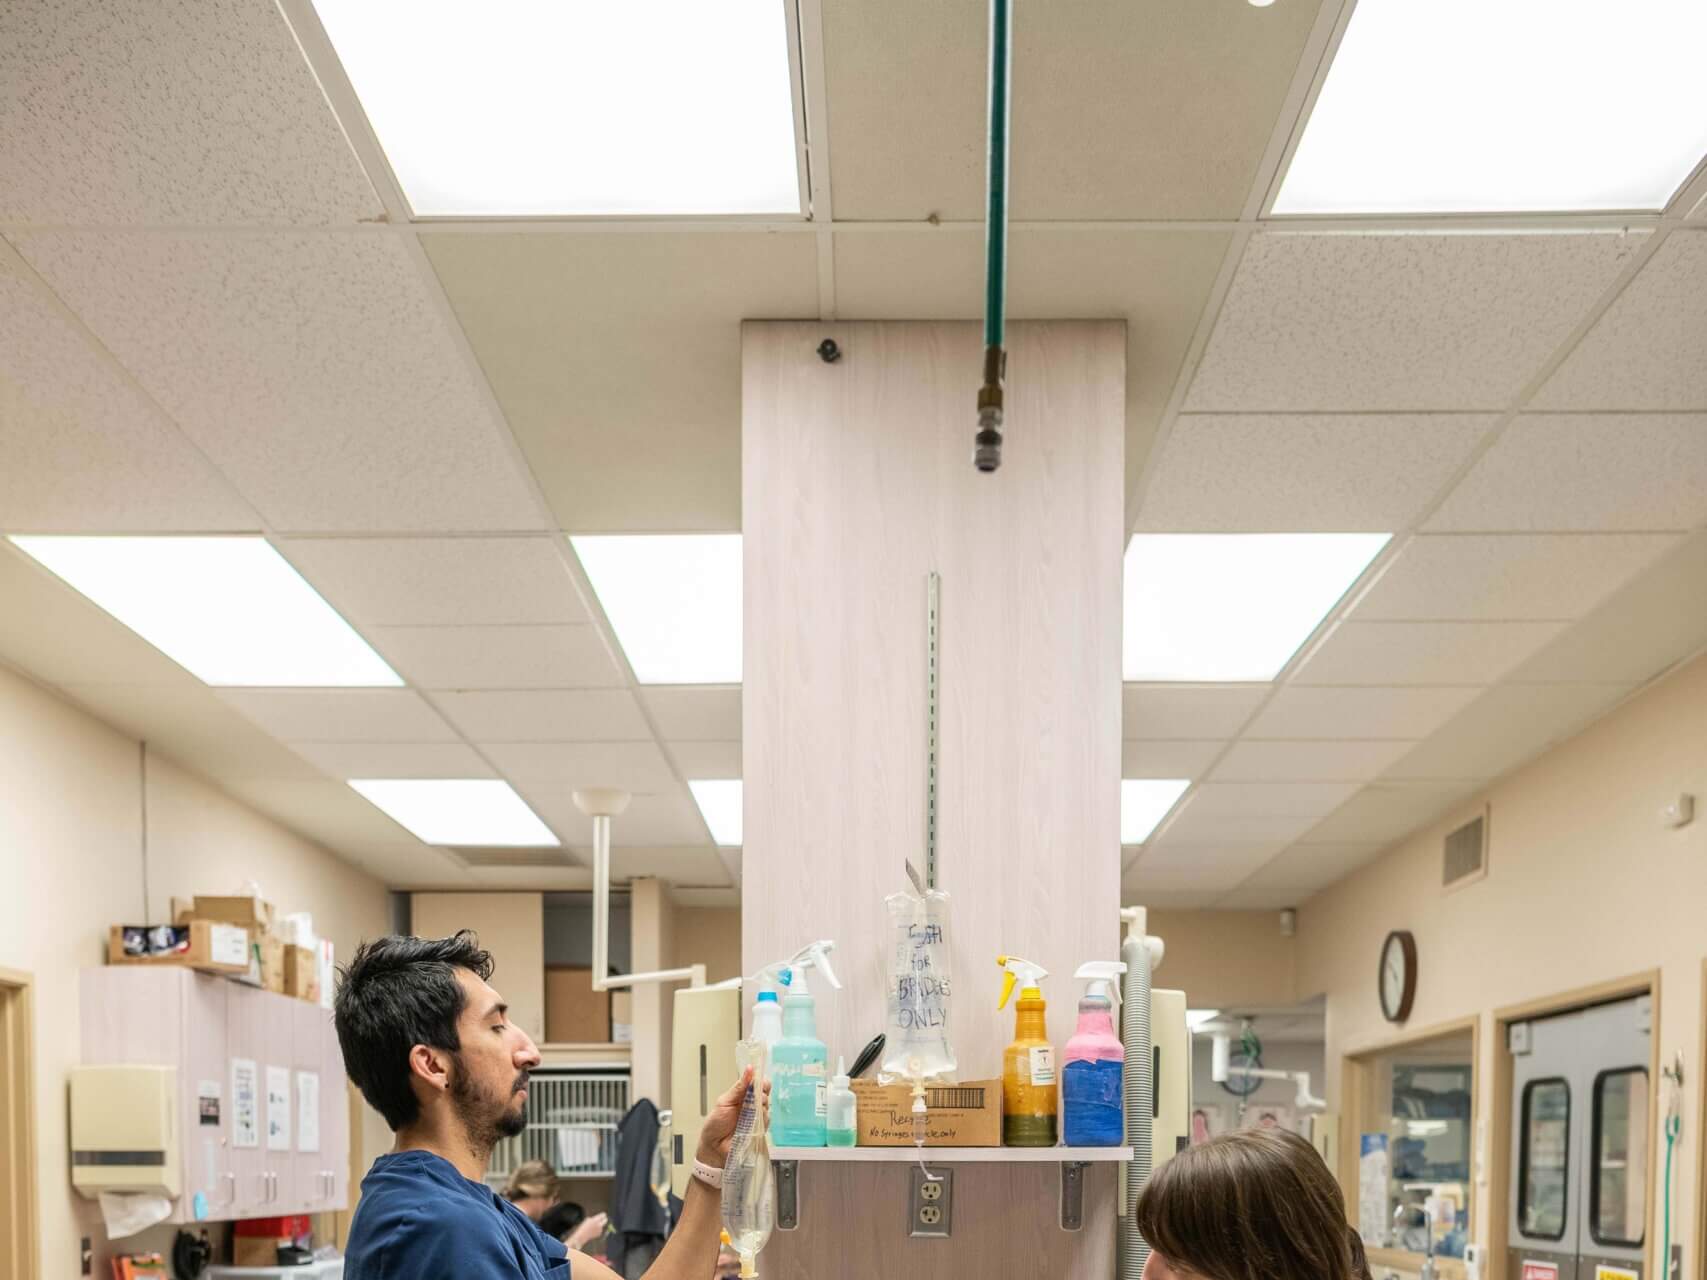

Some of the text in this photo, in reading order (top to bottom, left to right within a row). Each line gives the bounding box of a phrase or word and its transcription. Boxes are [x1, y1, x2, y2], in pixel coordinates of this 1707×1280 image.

[898, 1007, 946, 1030] ONLY
[890, 1110, 929, 1127] Recye
[881, 1128, 910, 1140] Syringes
[940, 1127, 957, 1139] only
